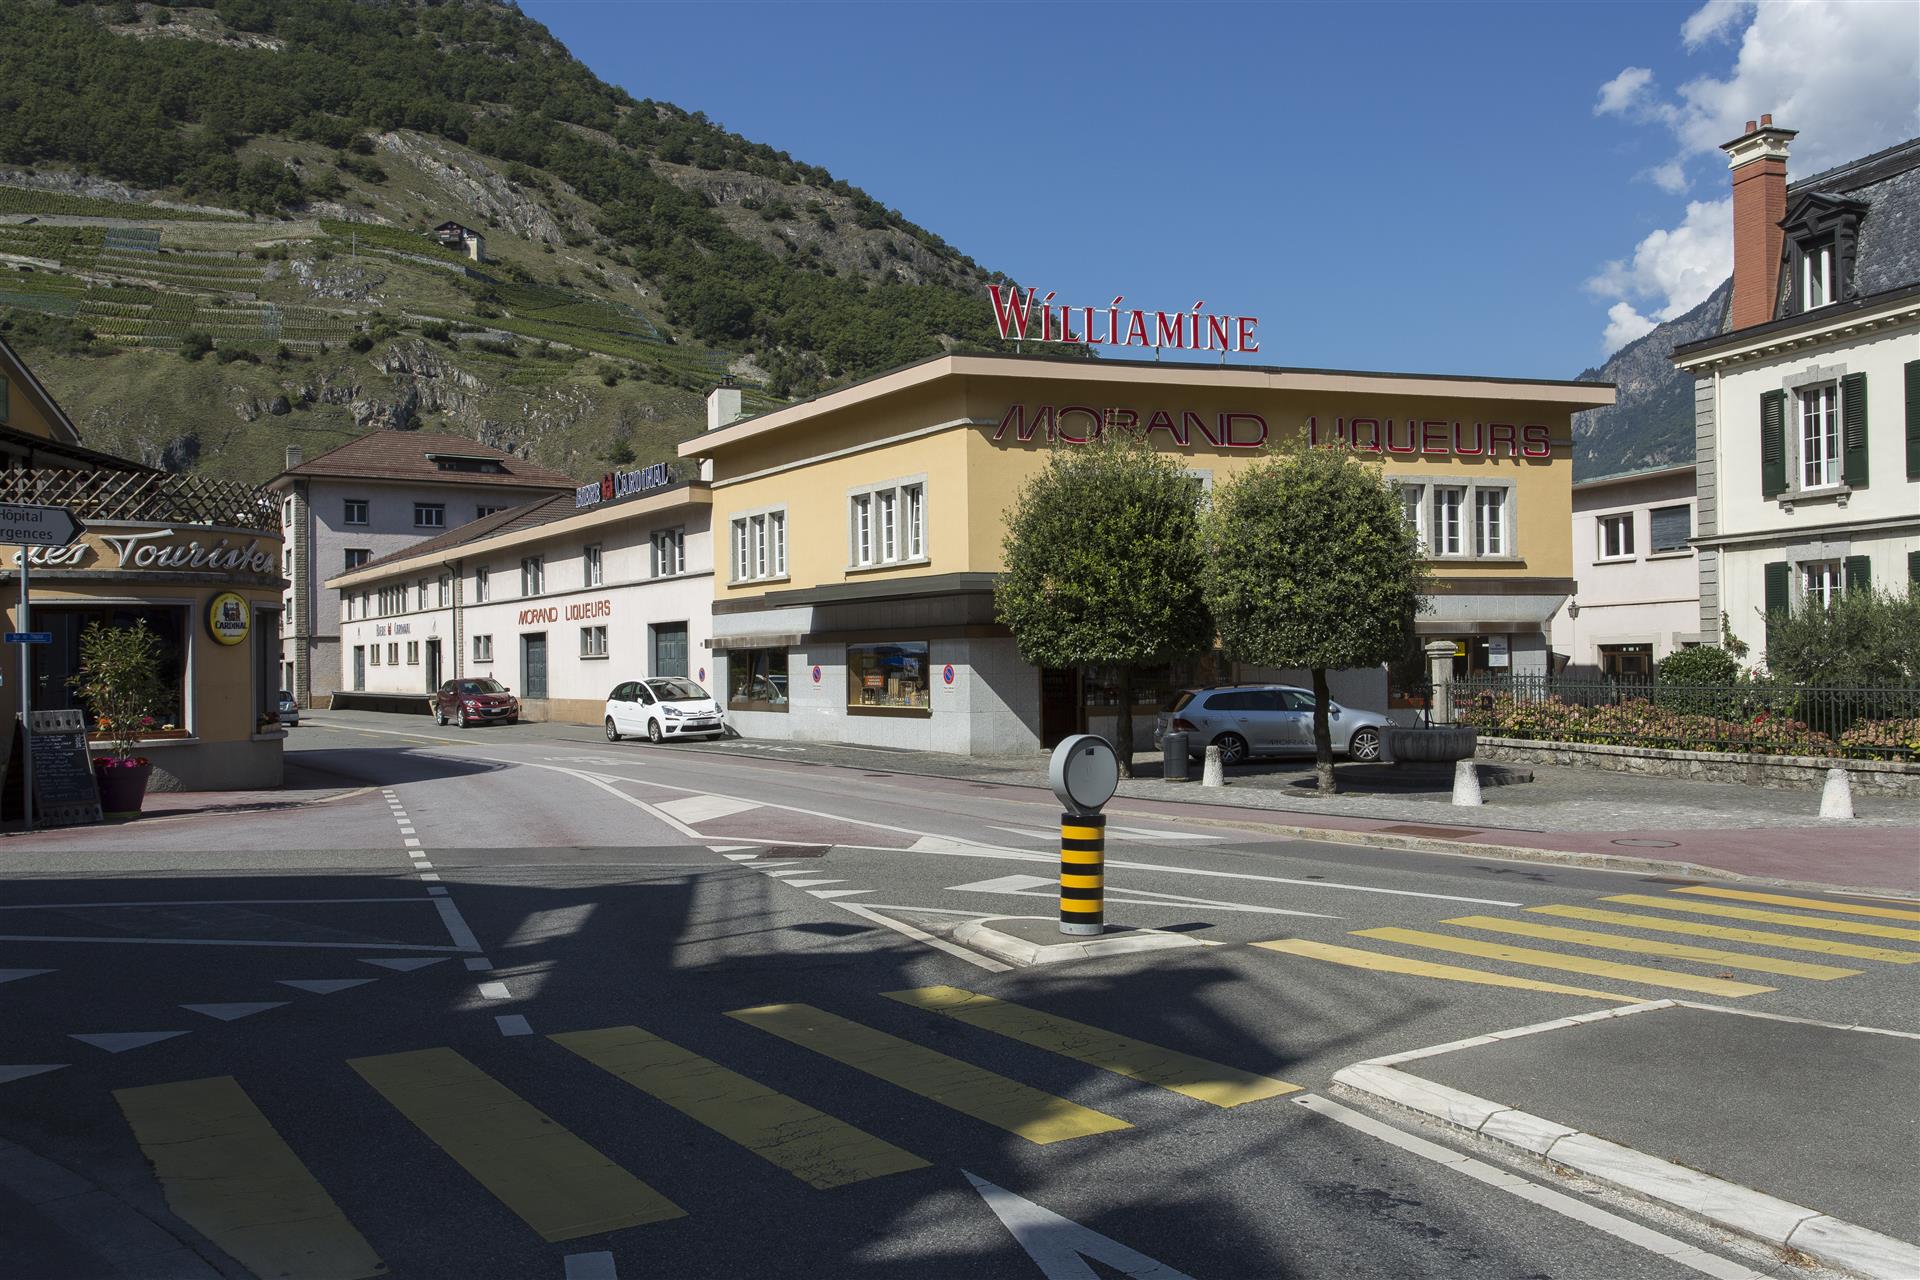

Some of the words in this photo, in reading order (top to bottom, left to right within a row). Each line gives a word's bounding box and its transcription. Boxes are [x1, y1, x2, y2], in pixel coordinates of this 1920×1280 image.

[993, 404, 1269, 447] MORAND
[1309, 416, 1551, 457] LIQUEURS
[0, 528, 53, 540] rgences
[99, 528, 274, 573] Touristes
[215, 620, 248, 630] CARDINAL
[518, 606, 558, 625] MORAND
[565, 600, 611, 621] LIQUEURS
